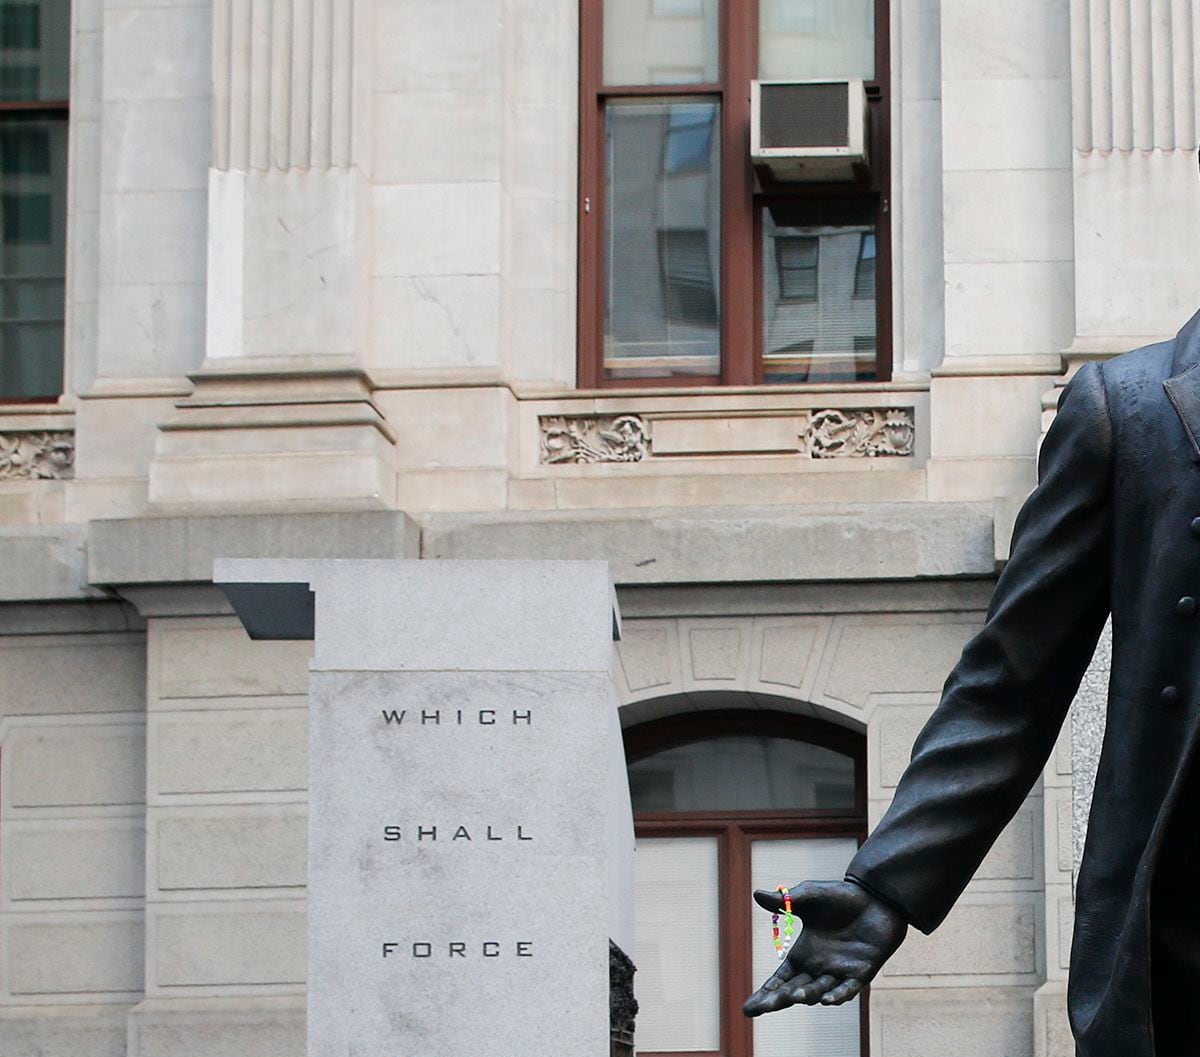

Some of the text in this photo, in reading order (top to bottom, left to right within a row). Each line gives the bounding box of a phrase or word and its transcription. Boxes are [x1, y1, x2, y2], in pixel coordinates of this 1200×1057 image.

[381, 709, 532, 726] WHICH
[382, 824, 534, 842] SHALL
[381, 940, 534, 959] FORCE
